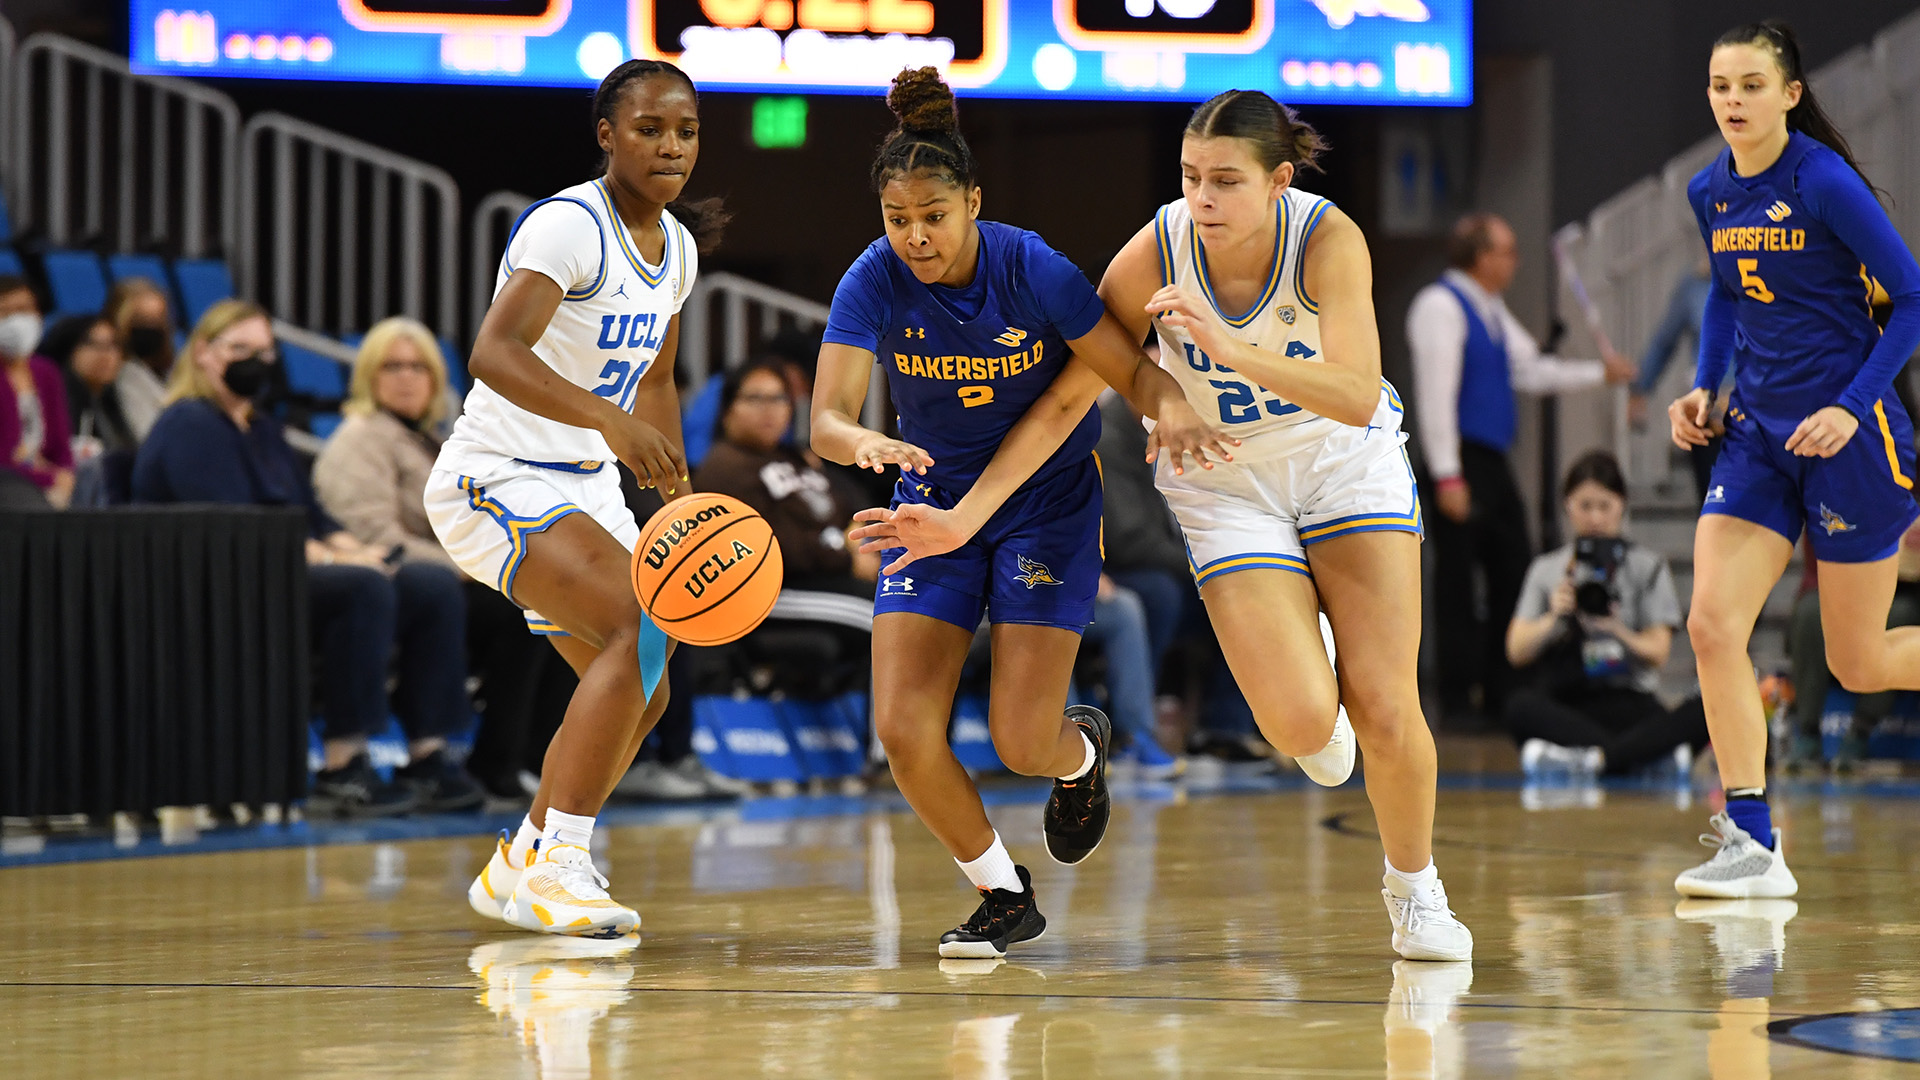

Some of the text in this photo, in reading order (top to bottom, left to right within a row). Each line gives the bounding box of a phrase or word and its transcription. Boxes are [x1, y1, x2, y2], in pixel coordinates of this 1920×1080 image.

[1737, 258, 1775, 304] 5
[894, 339, 1044, 380] BAKERSFIELD
[1183, 340, 1317, 373] UA
[957, 385, 995, 408] 2
[644, 504, 731, 570] Wilson
[684, 540, 753, 599] UCLA
